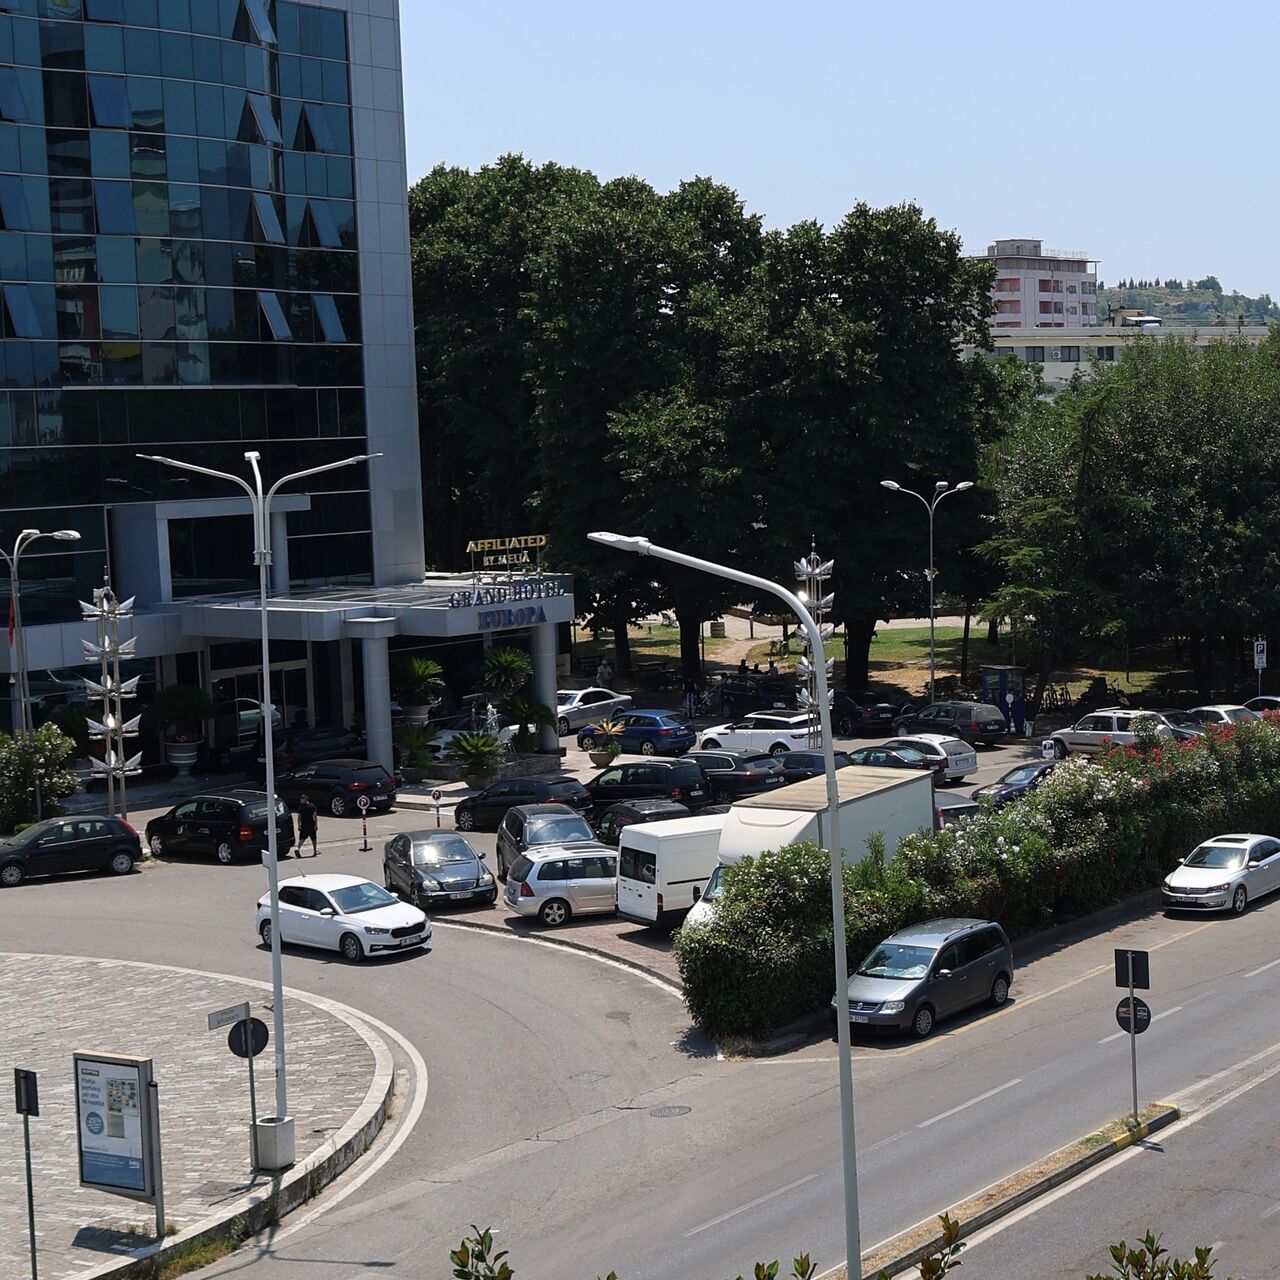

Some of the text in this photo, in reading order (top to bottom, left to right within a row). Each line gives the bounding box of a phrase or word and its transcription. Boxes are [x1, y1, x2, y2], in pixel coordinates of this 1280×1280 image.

[466, 534, 547, 553] AFFILIATED
[449, 581, 565, 608] GRAND HOTEL
[477, 604, 548, 631] EUROPA
